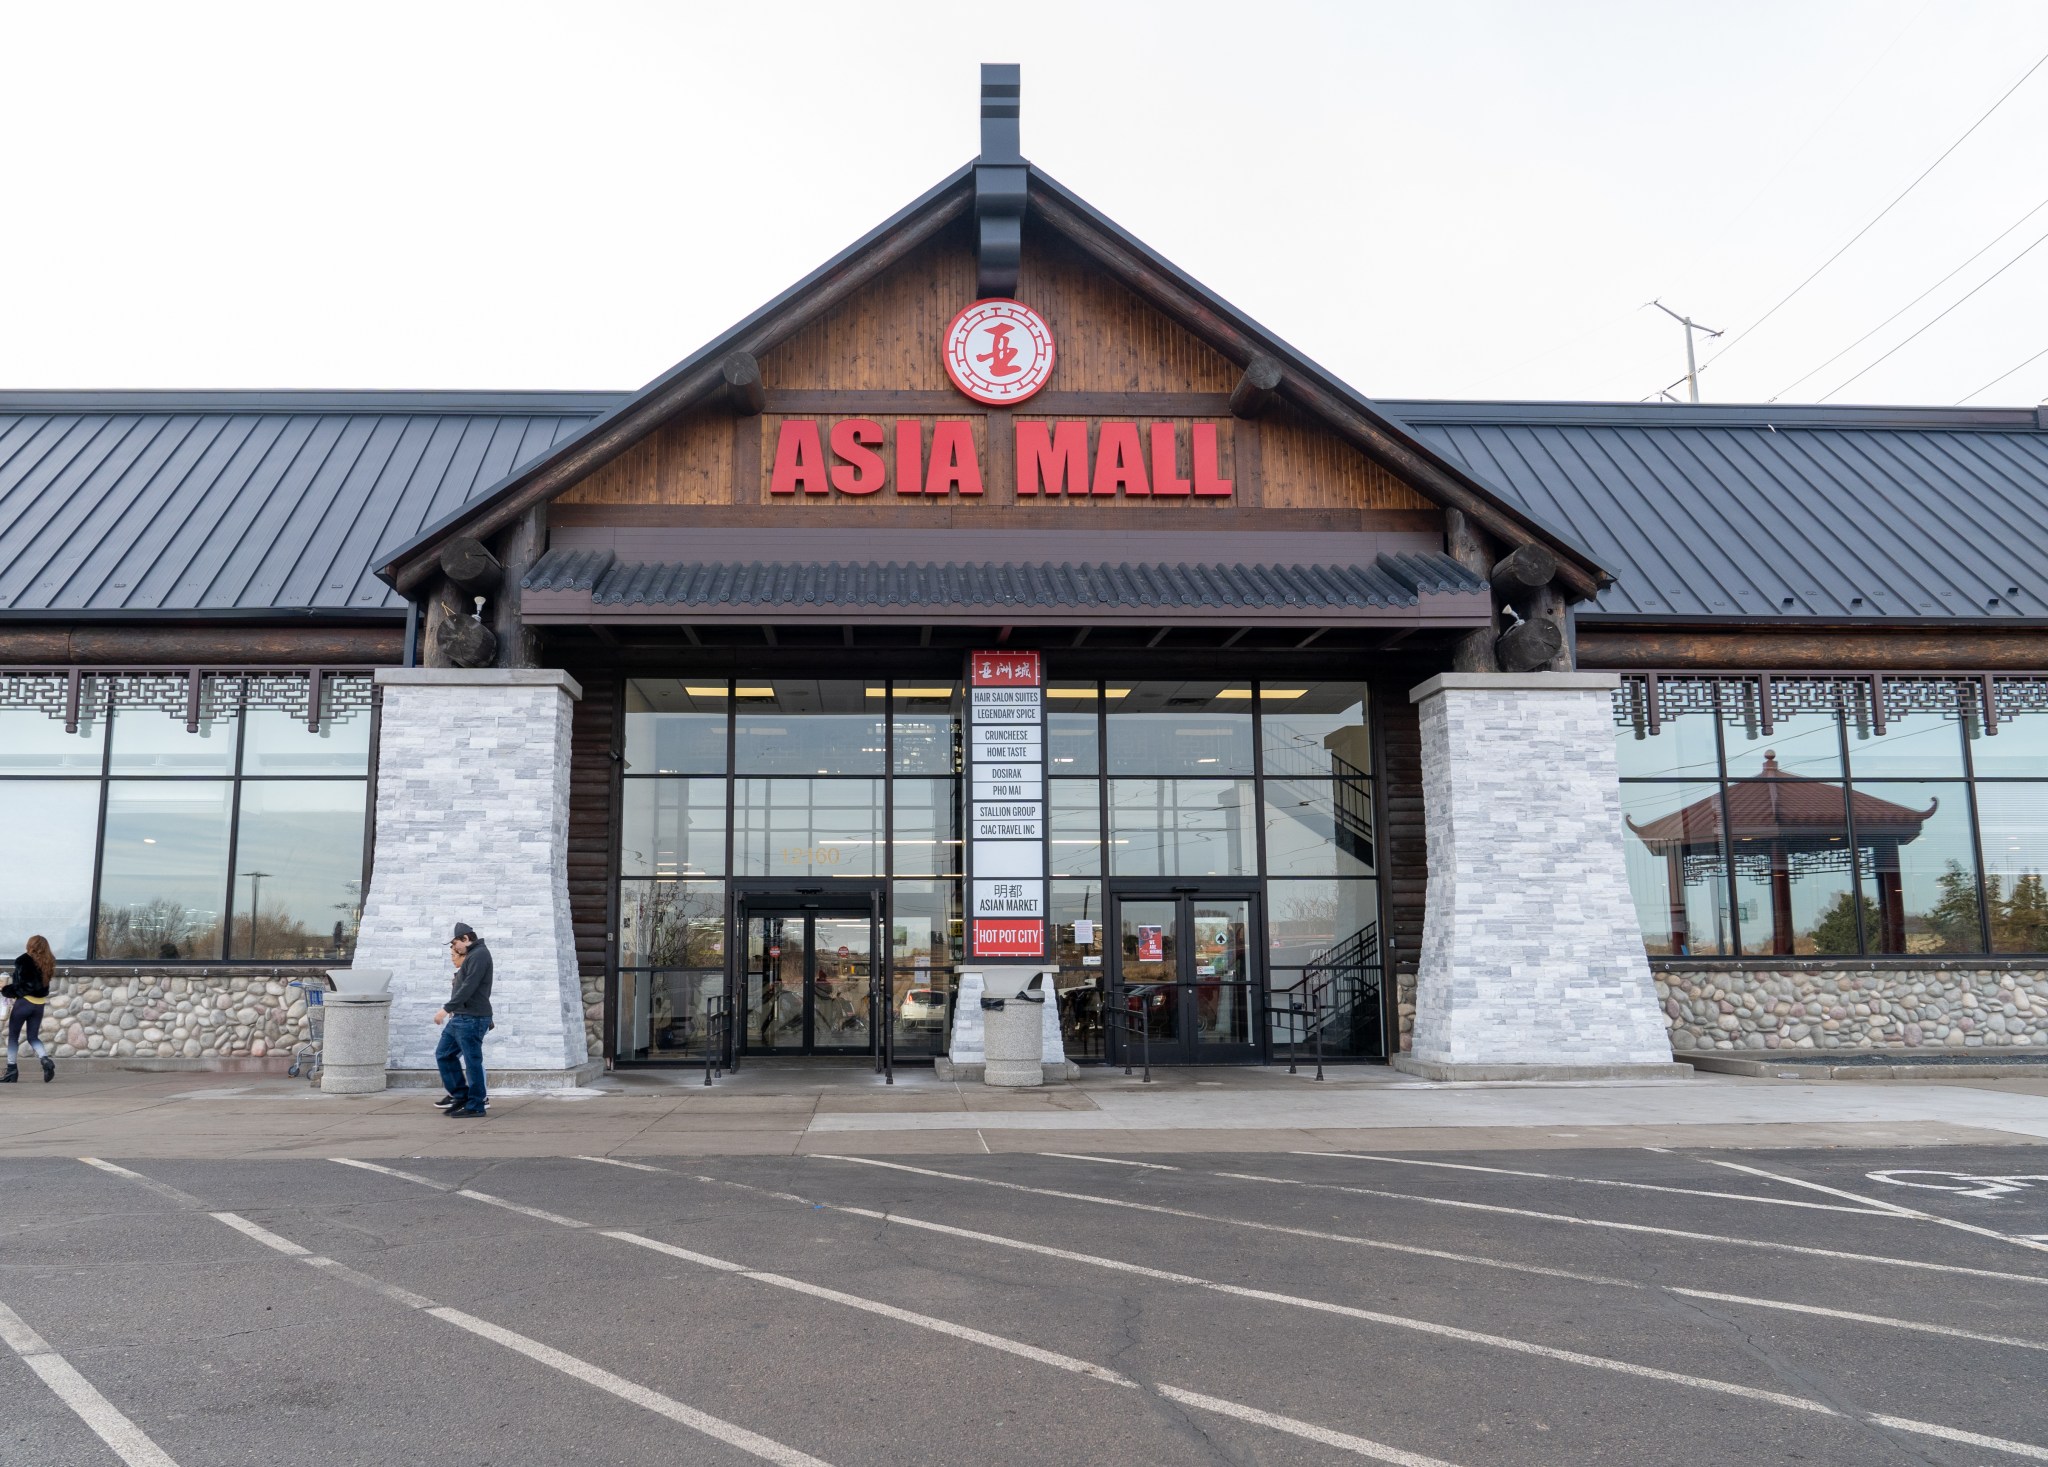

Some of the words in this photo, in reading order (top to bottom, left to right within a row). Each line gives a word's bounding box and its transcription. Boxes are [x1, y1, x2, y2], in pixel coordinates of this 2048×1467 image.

[770, 419, 983, 496] ASIA
[1016, 421, 1233, 498] MALL
[979, 662, 1032, 680] 亚洲城
[974, 692, 991, 703] HAIR
[991, 692, 1015, 703] SALON
[1015, 692, 1039, 703] SUITES
[977, 708, 1015, 719] LEGENDARY
[1016, 708, 1036, 719] SPICE
[984, 730, 1028, 741] CRUNCHEESE
[986, 746, 1006, 757] HOME
[1007, 746, 1027, 757] TASTE
[992, 768, 1022, 779] DOSIRAK
[992, 785, 1007, 796] PHO
[1008, 785, 1022, 796] MAI
[979, 806, 1011, 817] STALLION
[1012, 806, 1036, 817] GROUP
[980, 824, 997, 835] CIAC
[997, 824, 1022, 835] TRAVEL
[1023, 824, 1035, 835] INC
[782, 847, 840, 864] 12160
[994, 884, 1023, 899] 明都
[979, 899, 1005, 912] ASIAN
[1006, 899, 1038, 912] MARKET
[979, 929, 997, 944] HOT
[998, 929, 1016, 944] POT
[1017, 929, 1039, 944] CITY
